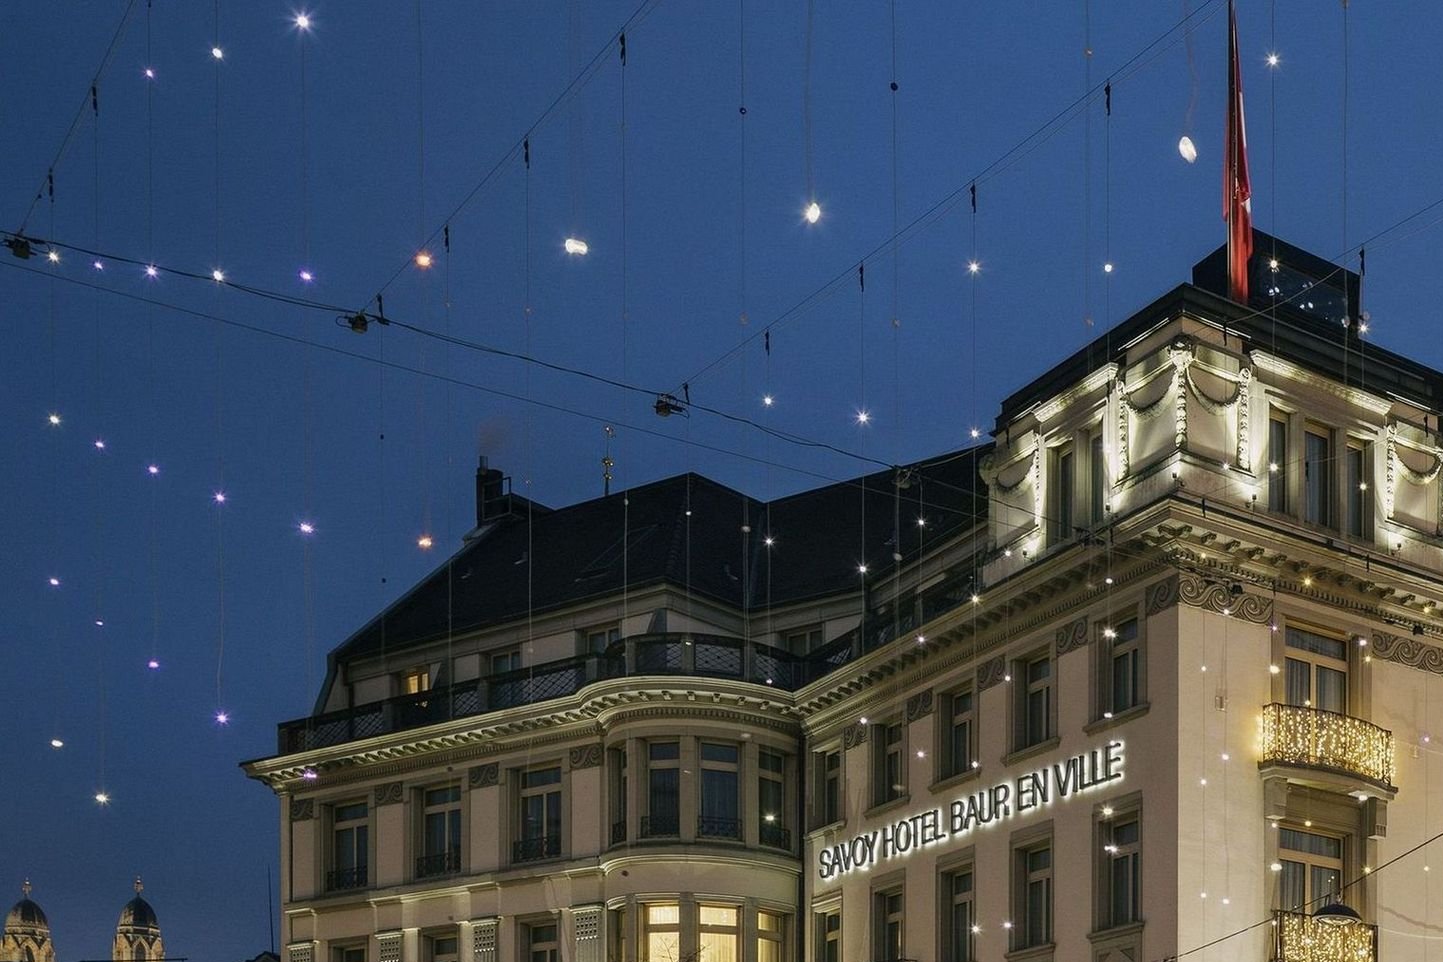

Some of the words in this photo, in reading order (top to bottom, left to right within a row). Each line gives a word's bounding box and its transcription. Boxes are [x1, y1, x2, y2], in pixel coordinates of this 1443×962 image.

[819, 831, 878, 878] SAVOY
[883, 809, 946, 858] HOTEL
[951, 784, 1010, 834] BAUR
[1018, 769, 1049, 811] EN
[1054, 743, 1122, 796] VILLE
